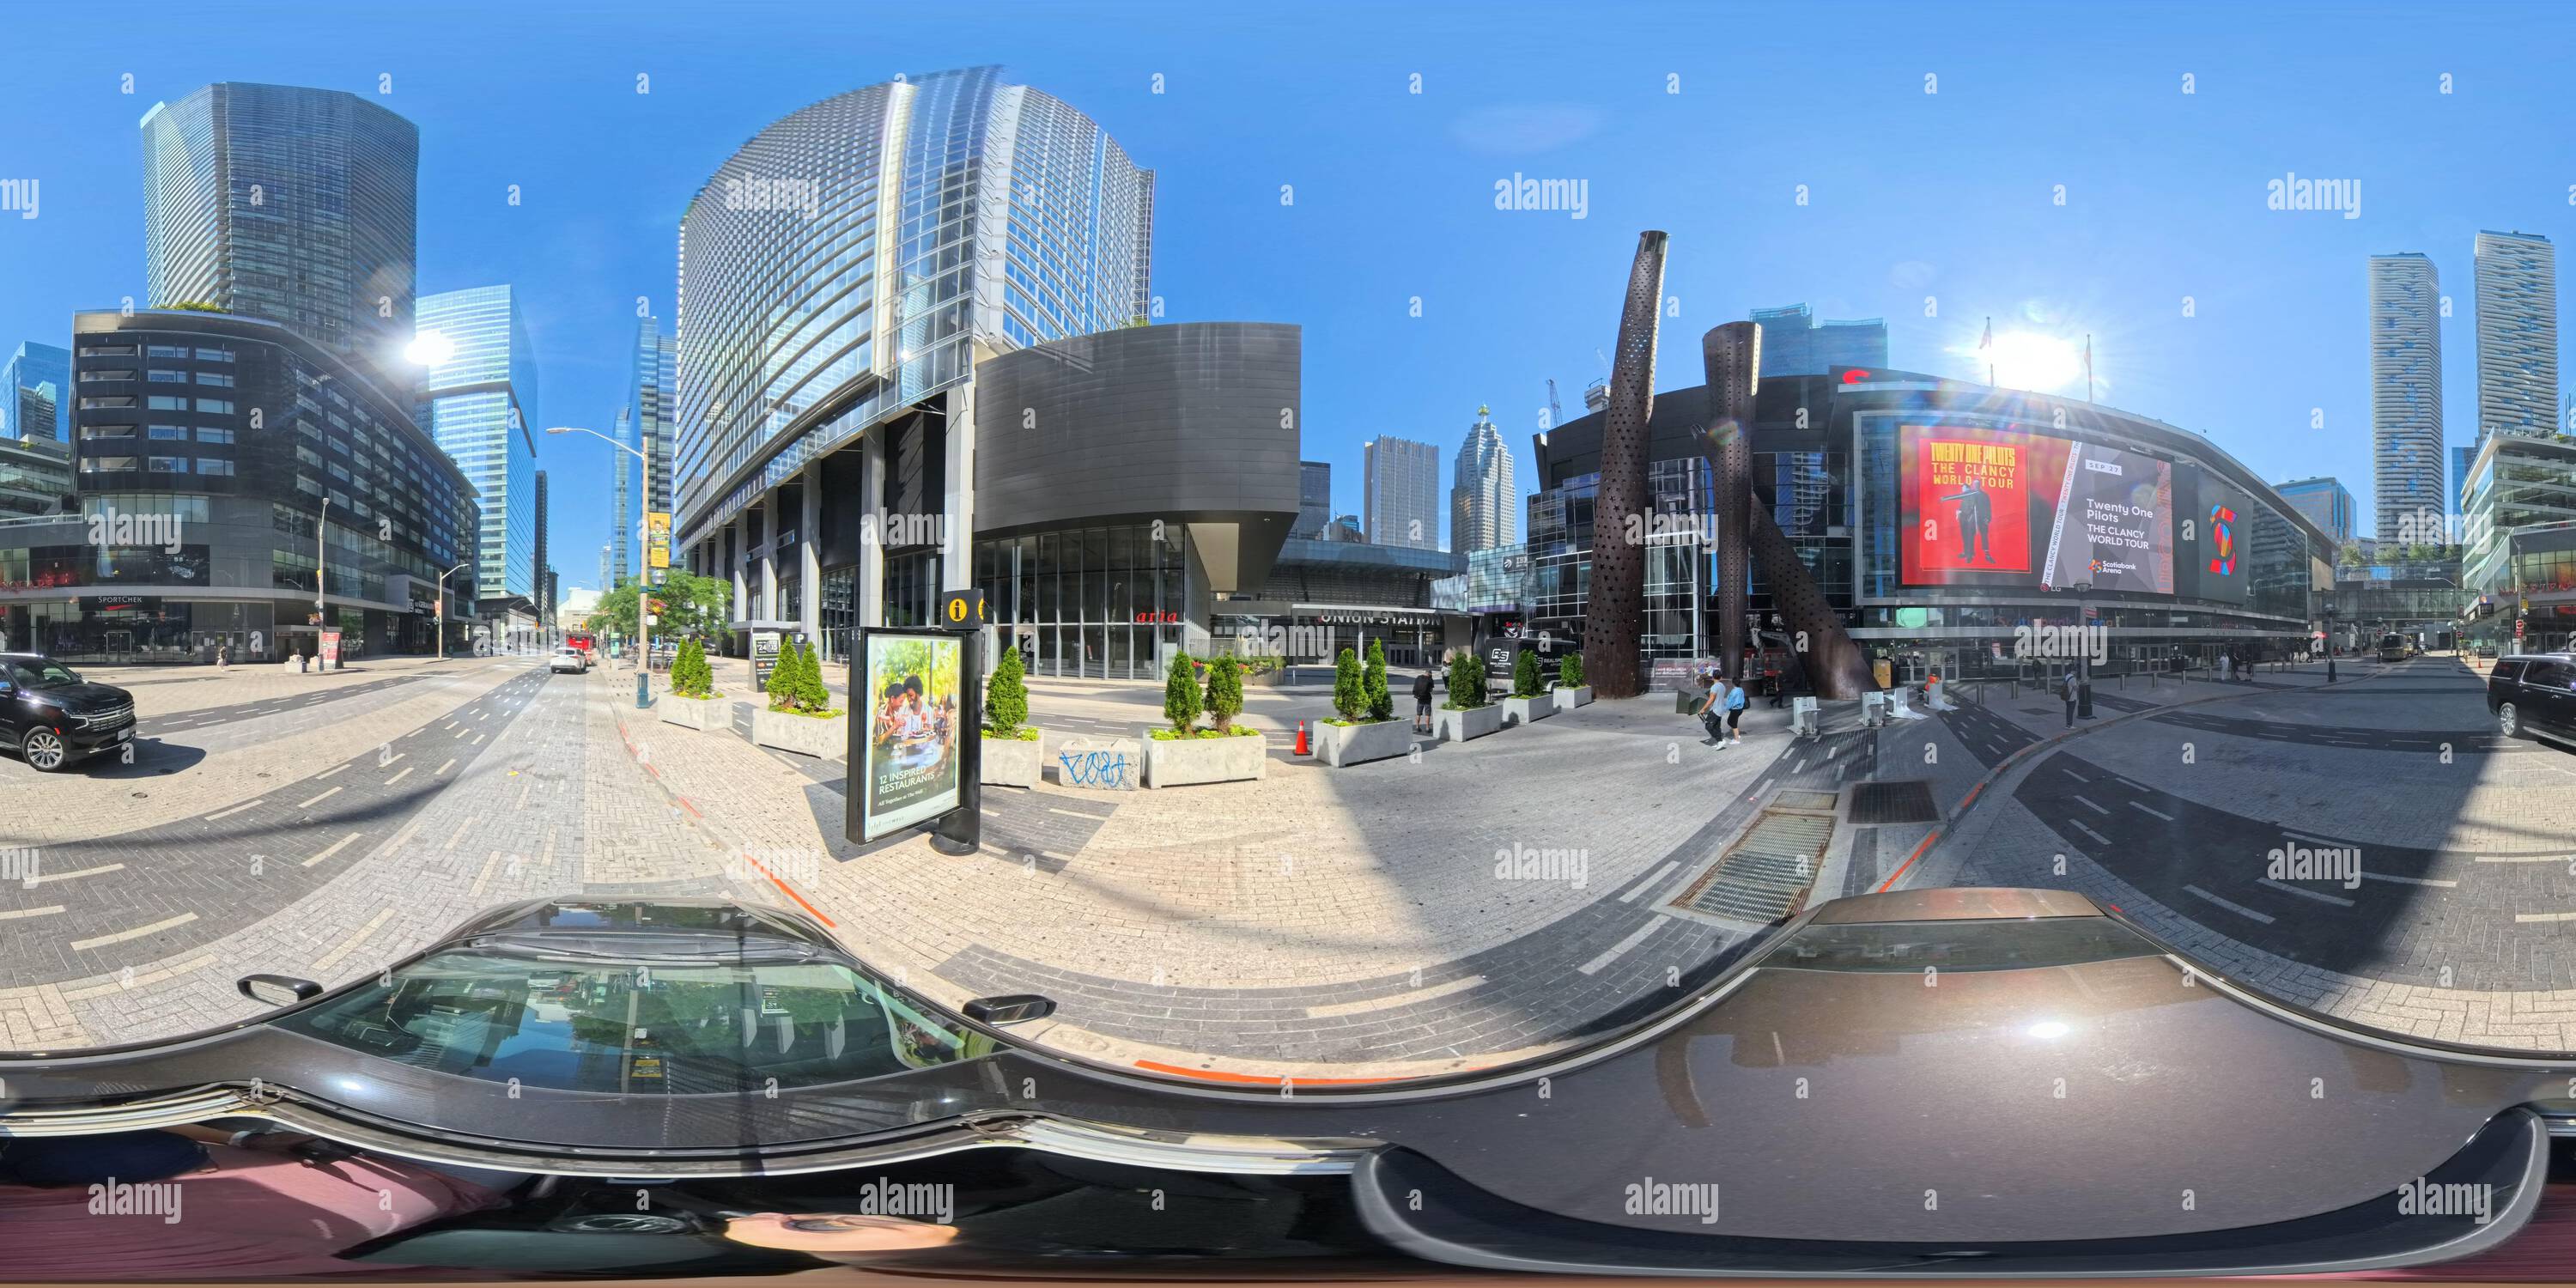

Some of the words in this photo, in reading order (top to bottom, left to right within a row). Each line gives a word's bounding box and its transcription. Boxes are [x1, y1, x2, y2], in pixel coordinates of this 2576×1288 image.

[1929, 442, 1965, 463] TWENTY
[1965, 444, 1983, 465] ONE
[1983, 445, 2016, 467] PILOTS
[1931, 463, 1955, 474] THE
[1965, 464, 2015, 478] CLANCY
[2089, 462, 2105, 471] SEP
[1933, 475, 1972, 486] WORLD
[1981, 477, 2014, 489] TOUR
[2087, 498, 2129, 516] Twenty
[2131, 506, 2154, 519] One
[2087, 509, 2119, 523] Pilots
[2087, 524, 2106, 534] THE
[2107, 526, 2146, 539] CLANCY
[2087, 534, 2123, 547] WORLD
[2124, 538, 2149, 550] TOUR
[2102, 560, 2137, 570] Scotiabank
[2102, 566, 2122, 574] Arena
[1136, 610, 1177, 623] aria
[1321, 609, 1374, 624] UNION
[1380, 611, 1442, 626] STATION
[795, 634, 805, 643] P
[879, 775, 888, 785] 12
[890, 766, 927, 781] INSPIRED
[878, 772, 935, 795] RESTAURANTS
